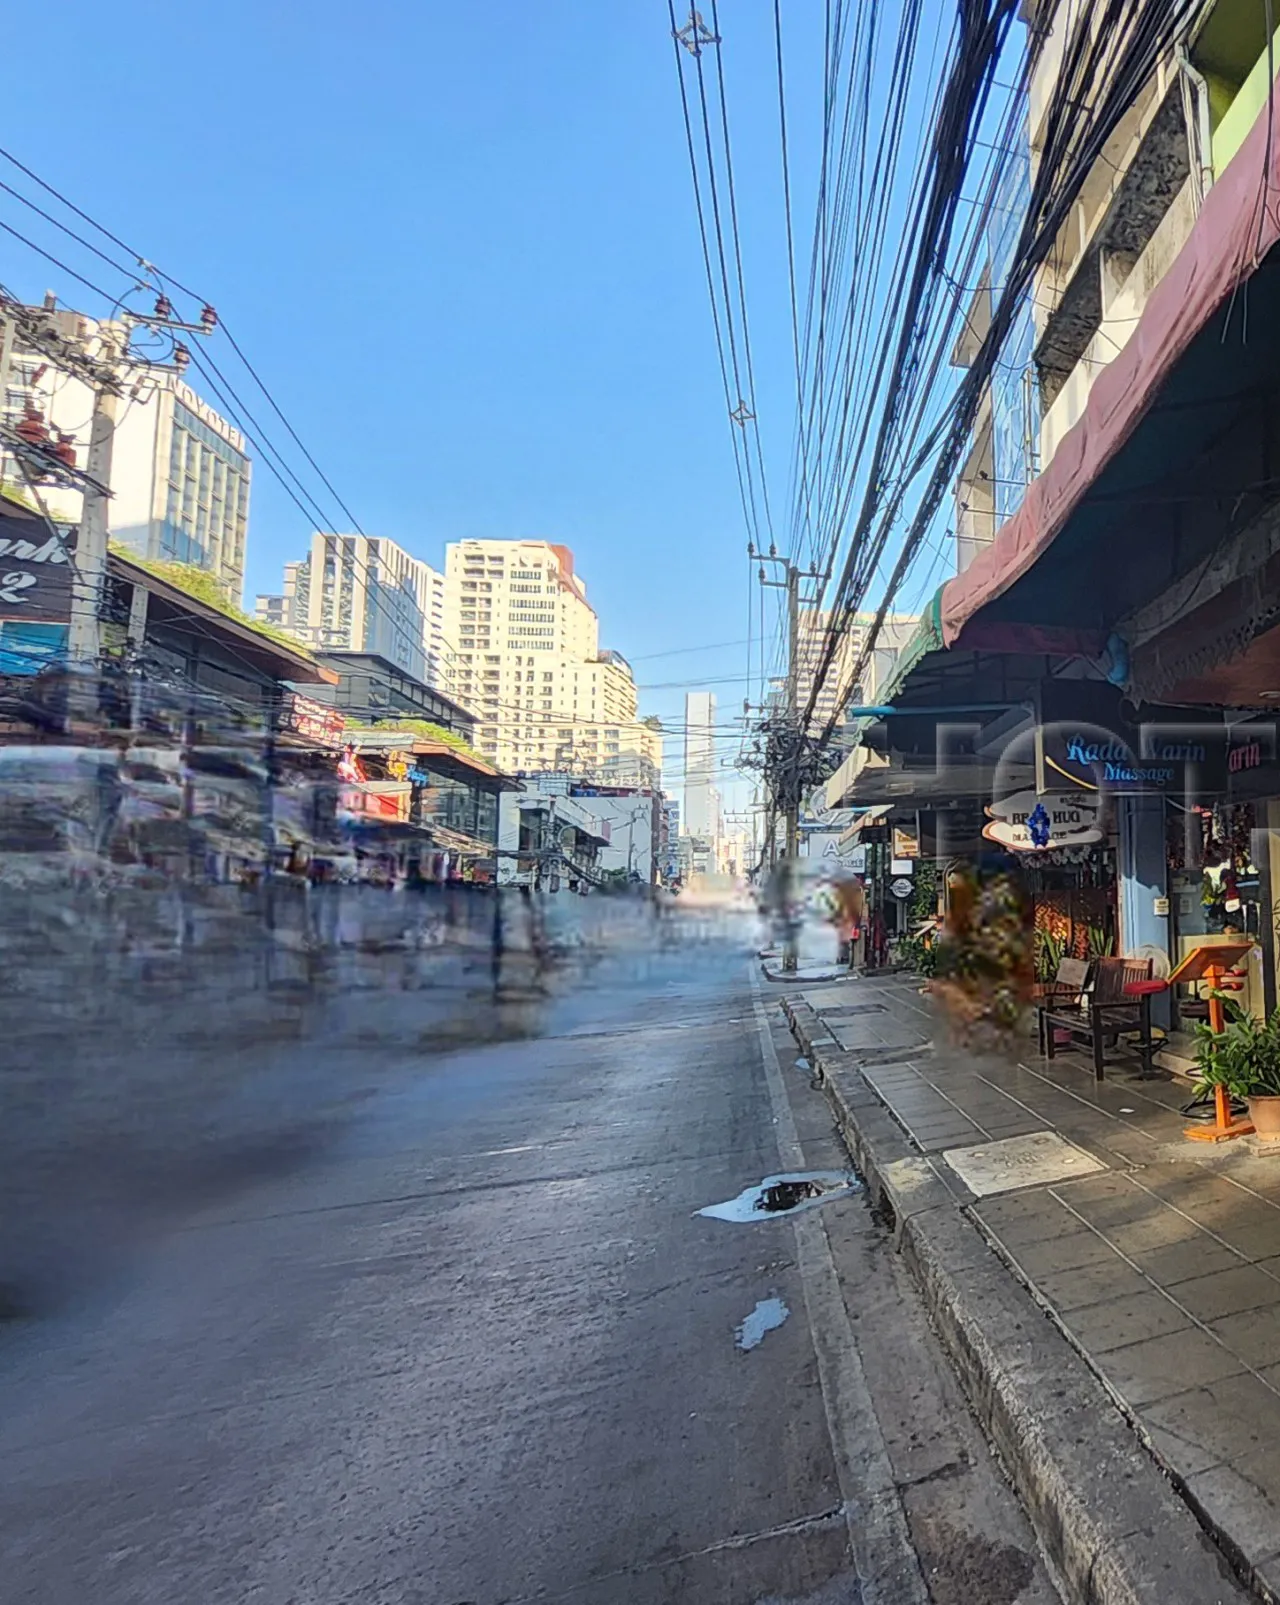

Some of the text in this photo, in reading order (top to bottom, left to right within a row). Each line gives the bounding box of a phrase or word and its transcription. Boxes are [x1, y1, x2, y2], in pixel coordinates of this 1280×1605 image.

[170, 374, 245, 452] NOVOTEL
[1066, 733, 1127, 765] Rada
[1228, 738, 1260, 774] arin
[1103, 763, 1175, 786] Massage
